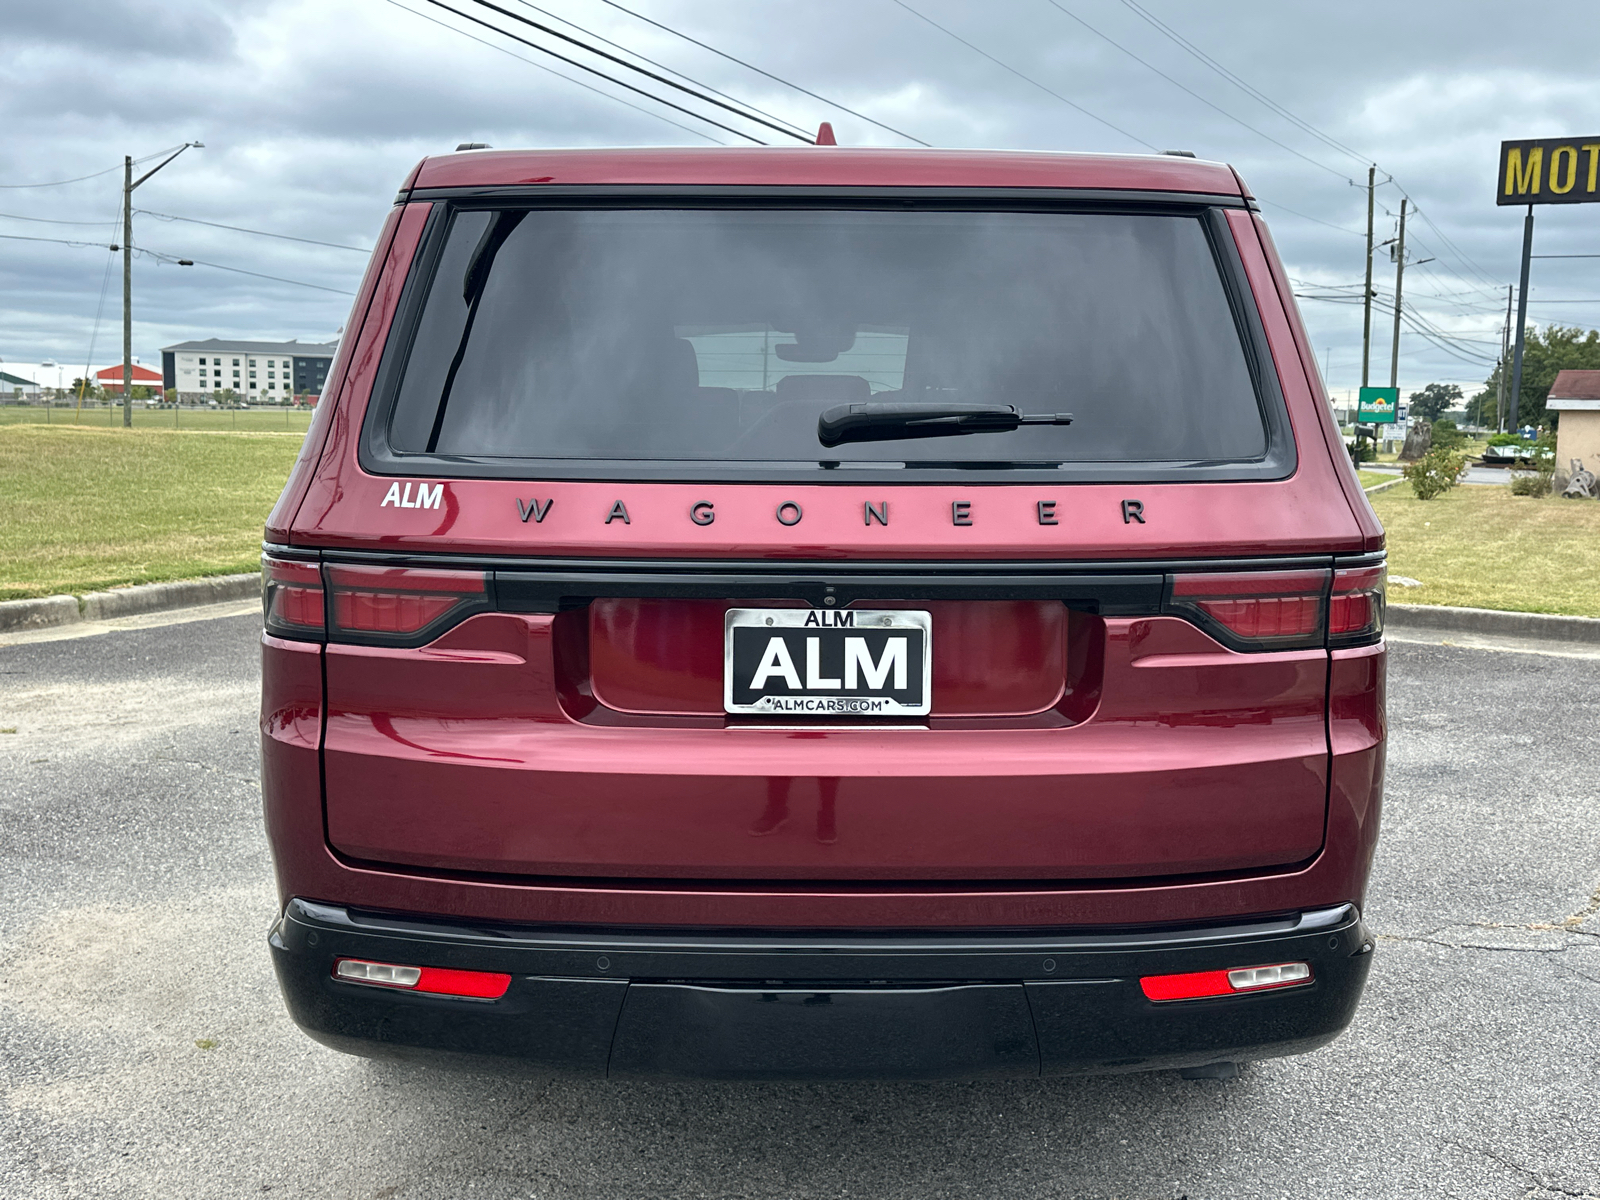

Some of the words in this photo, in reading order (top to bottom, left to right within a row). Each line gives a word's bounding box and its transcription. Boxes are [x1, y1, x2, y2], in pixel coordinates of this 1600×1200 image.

[1361, 402, 1394, 413] Budgetel
[380, 482, 444, 509] ALM
[515, 497, 1146, 526] WAGONEER
[804, 611, 854, 627] ALM
[749, 636, 908, 690] ALM
[773, 699, 882, 711] ALMCARS.COM
